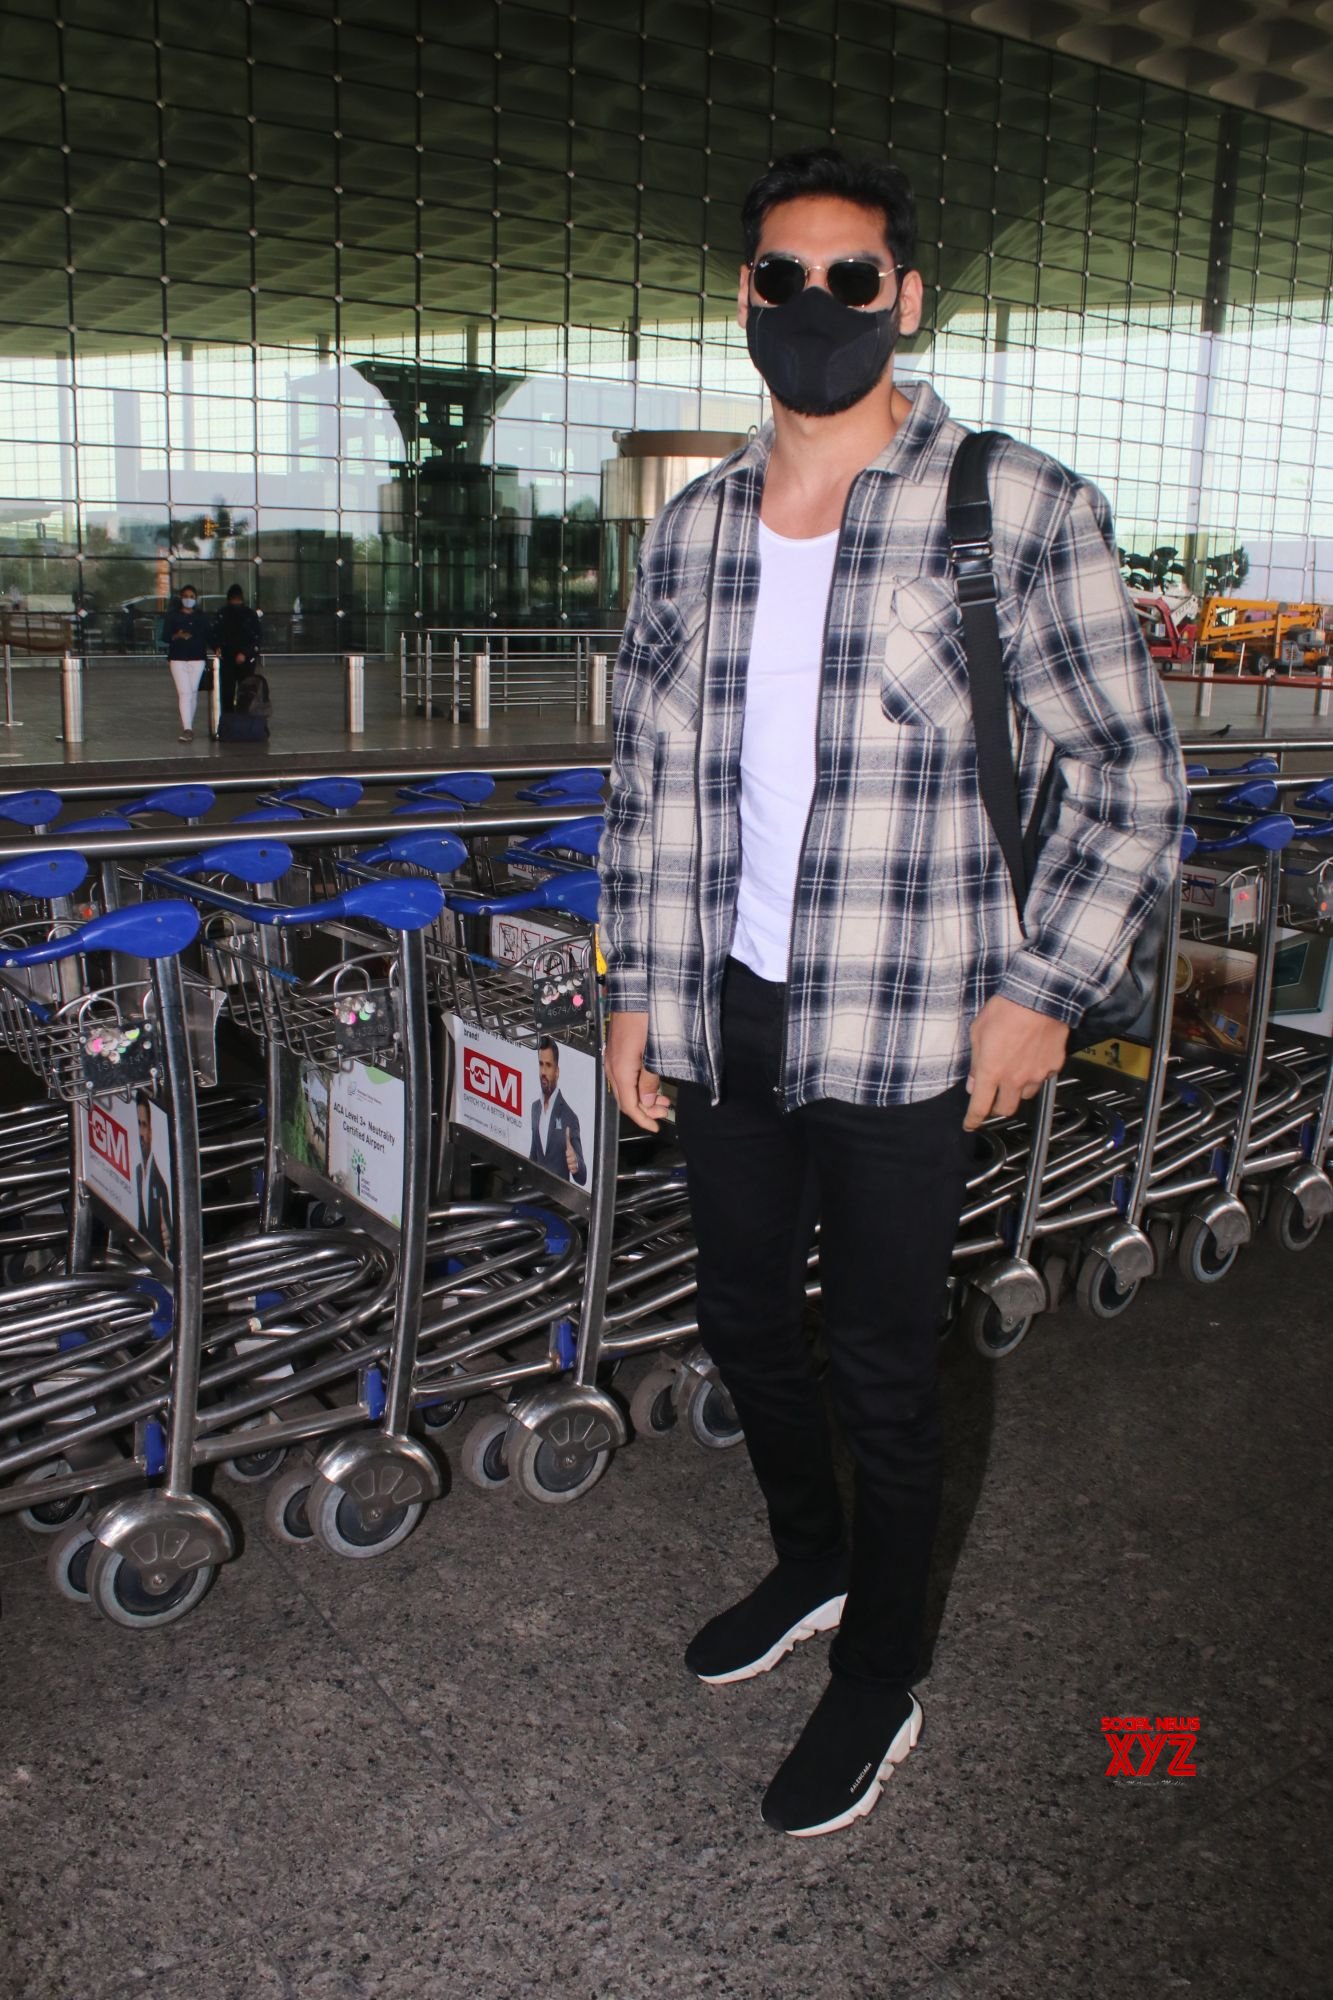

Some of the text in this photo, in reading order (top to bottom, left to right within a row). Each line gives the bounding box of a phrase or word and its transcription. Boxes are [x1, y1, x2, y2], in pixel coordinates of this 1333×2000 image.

[467, 1056, 517, 1109] GM
[333, 1101, 344, 1116] ACA
[345, 1108, 359, 1124] Level
[368, 1121, 396, 1147] Neutrality
[342, 1121, 385, 1153] Certified Airport
[479, 1100, 486, 1110] TO
[506, 1115, 522, 1129] WORLD
[90, 1109, 128, 1172] GM
